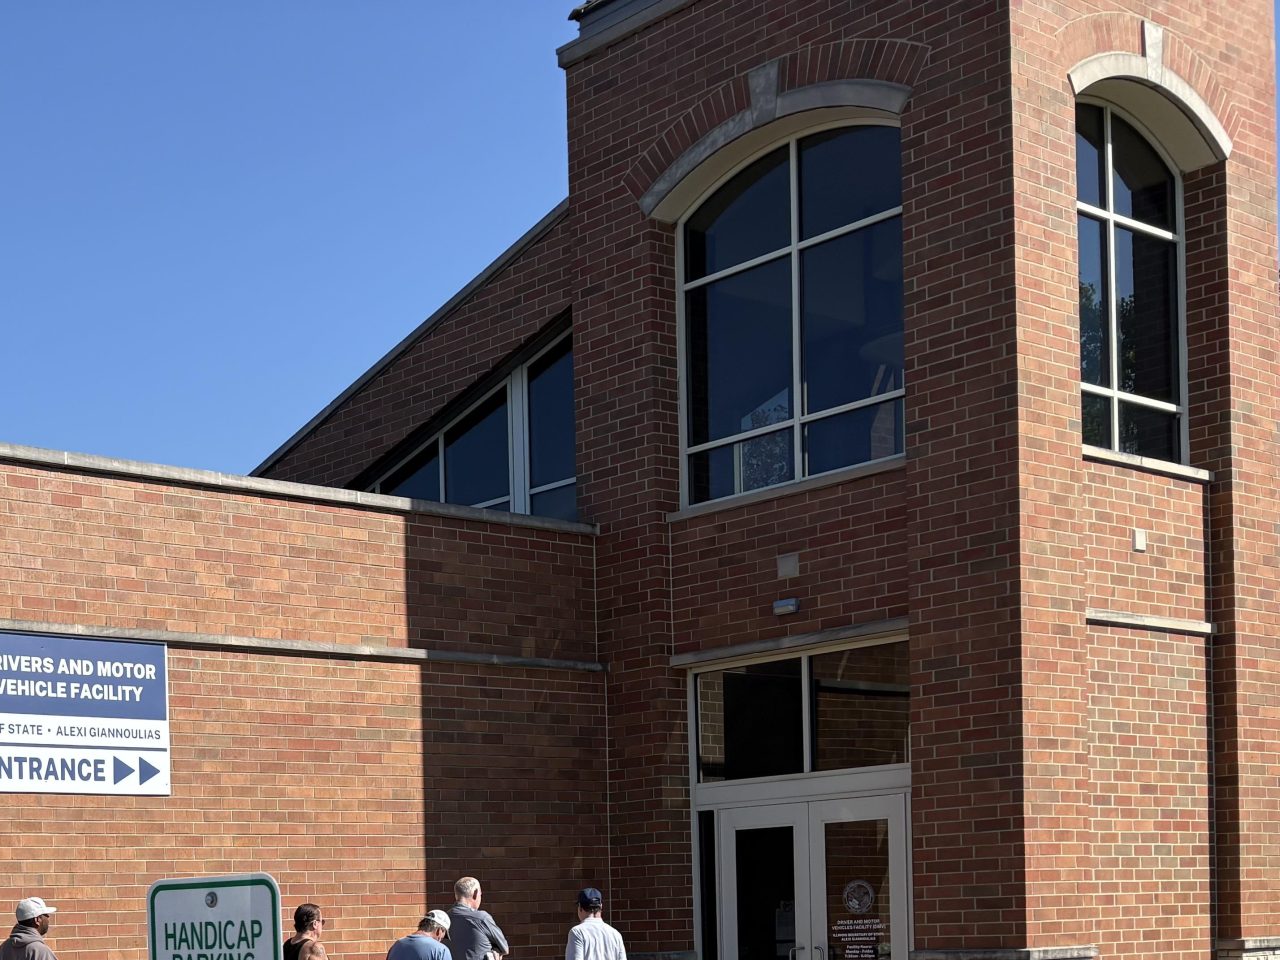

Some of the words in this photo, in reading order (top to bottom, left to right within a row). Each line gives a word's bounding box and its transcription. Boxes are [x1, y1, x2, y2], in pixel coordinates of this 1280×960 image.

[57, 658, 94, 676] AND
[97, 661, 156, 680] MOTOR
[70, 682, 144, 702] FACILITY
[8, 723, 43, 735] STATE
[56, 725, 87, 737] ALEXI
[89, 726, 161, 740] GIANNOULIAS
[164, 919, 263, 951] HANDICAP
